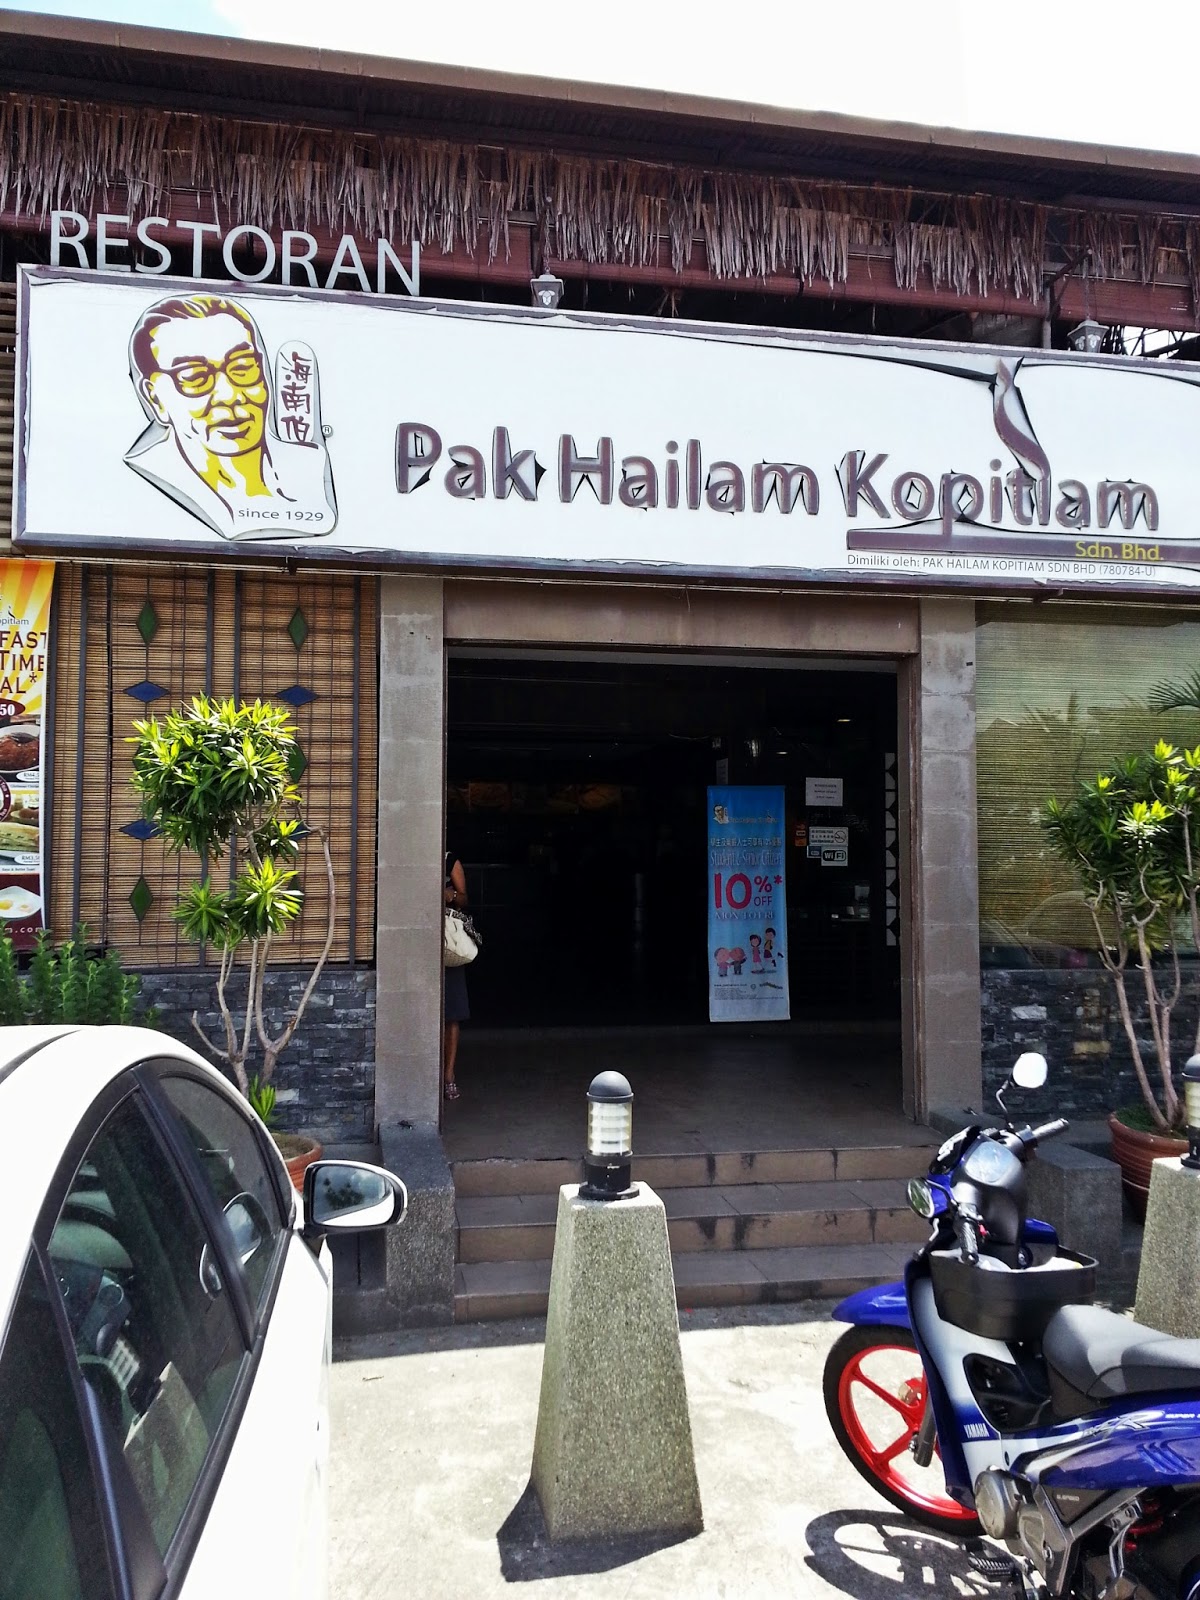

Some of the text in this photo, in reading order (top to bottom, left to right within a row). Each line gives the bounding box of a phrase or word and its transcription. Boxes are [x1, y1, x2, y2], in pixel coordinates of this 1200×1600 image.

[49, 210, 421, 296] RESTORAN
[280, 351, 314, 442] 海南伯
[394, 422, 1161, 538] Pak Hailam Kopitiam
[238, 507, 324, 522] since 1929
[1075, 541, 1165, 561] Sdn. Bhd.
[847, 554, 1156, 578] Dimiliki oleh: PAK HAILAM KOPITIAM SDN BHD (780784-U)
[753, 896, 772, 907] OFF
[964, 1423, 990, 1438] YAMAHA
